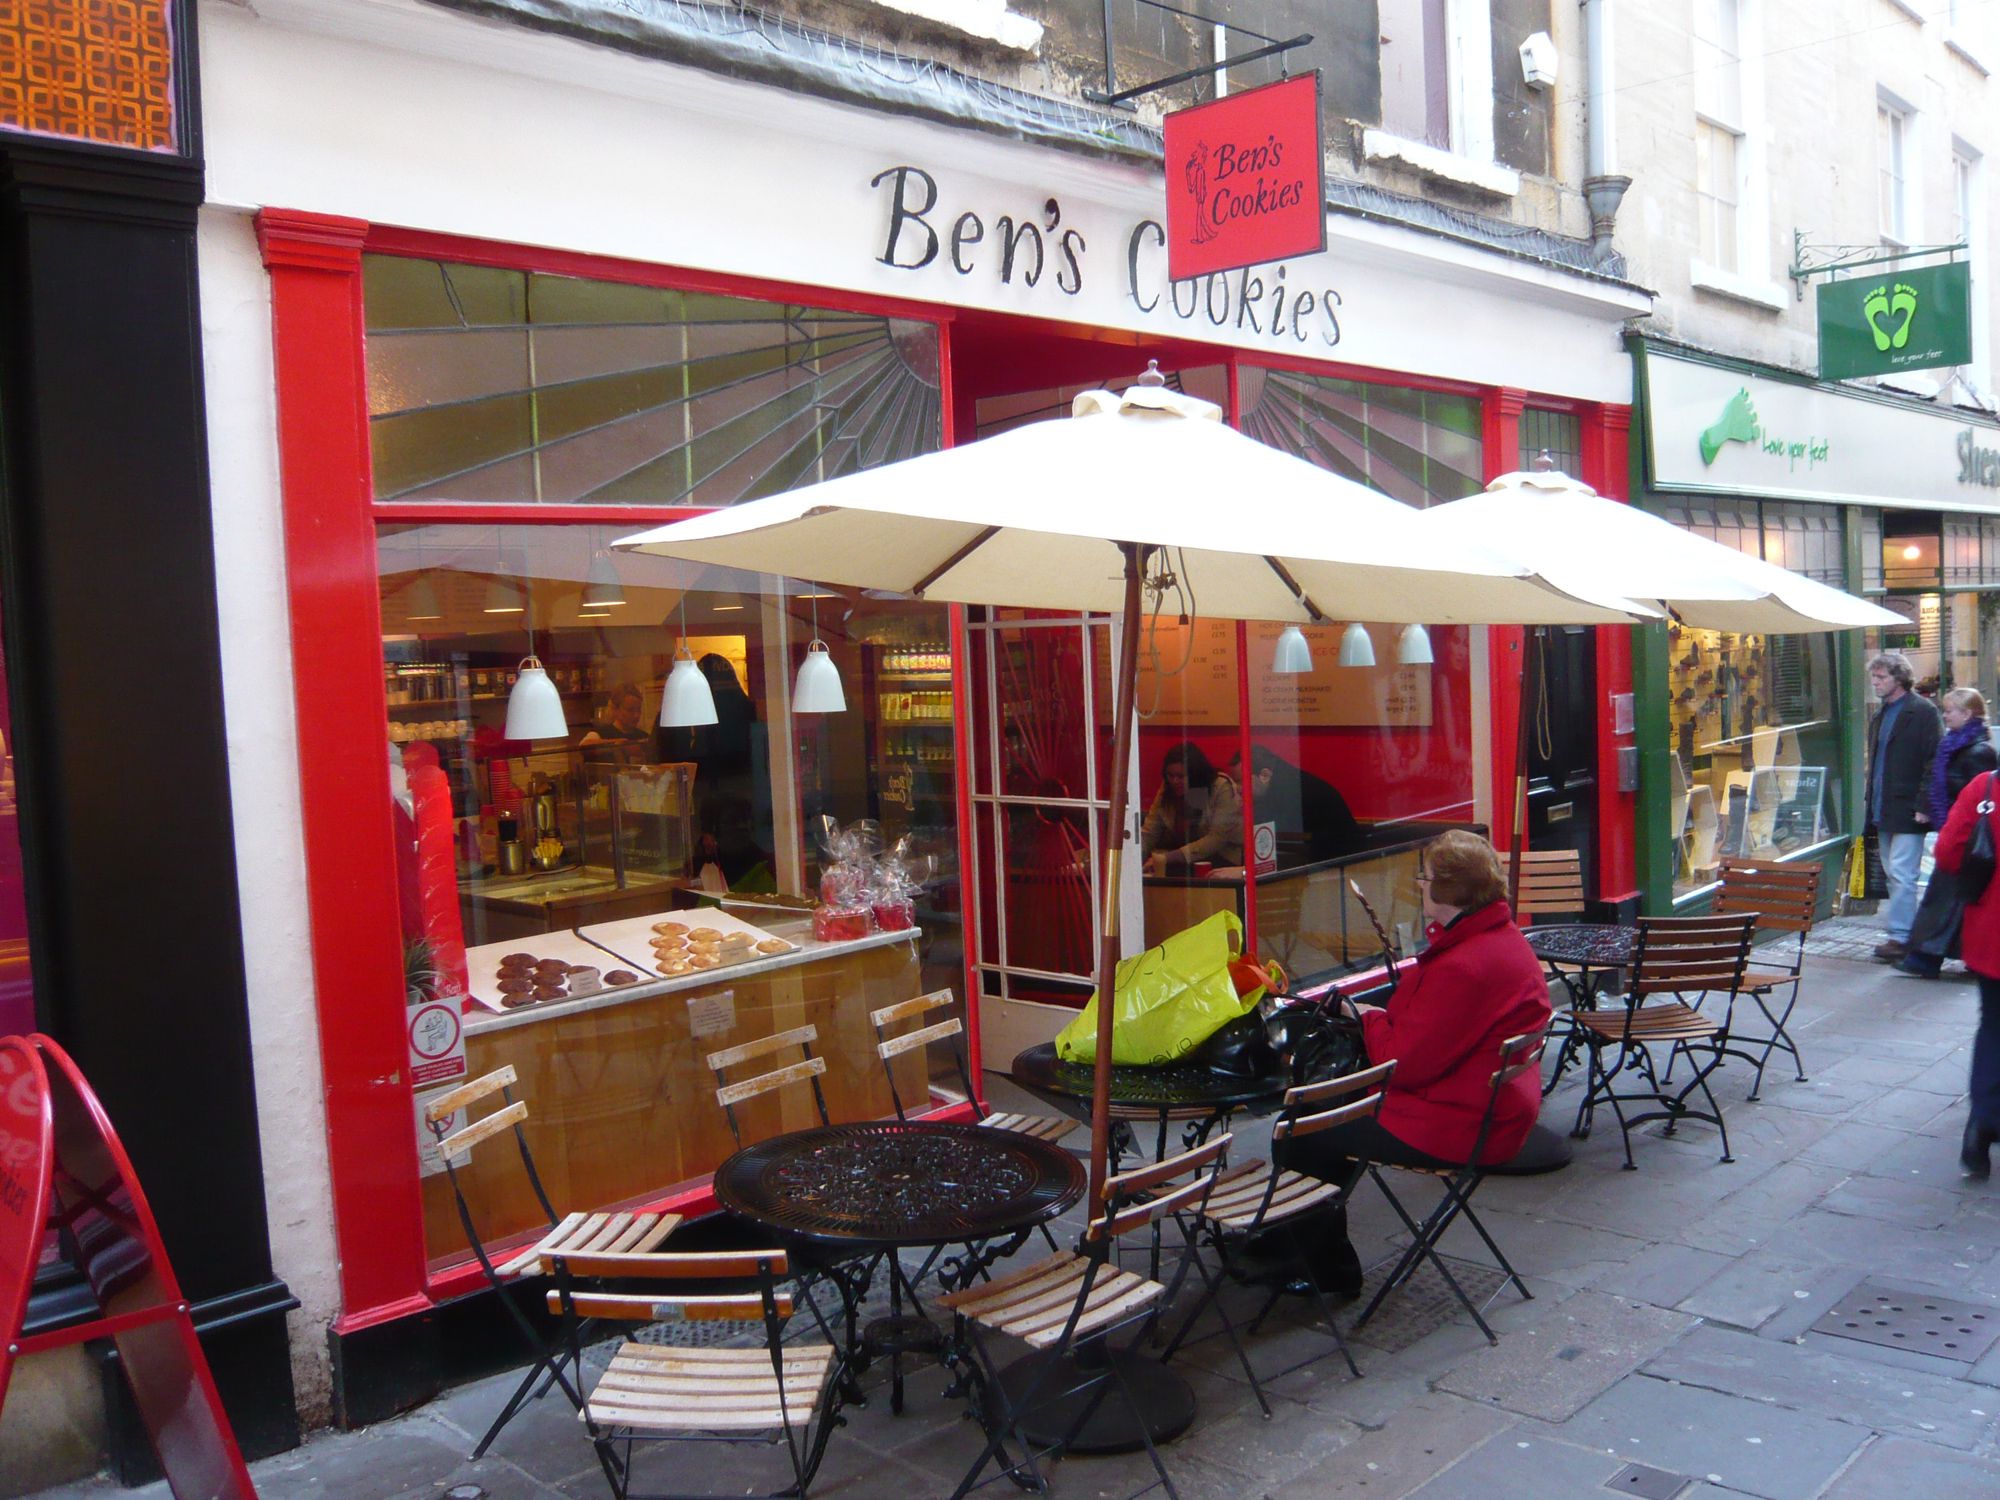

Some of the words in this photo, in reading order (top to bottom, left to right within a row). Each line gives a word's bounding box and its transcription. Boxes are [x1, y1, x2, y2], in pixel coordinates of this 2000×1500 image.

[1213, 134, 1283, 181] Ben's
[1212, 177, 1303, 226] Cookies
[871, 166, 1086, 295] Ben's
[1128, 219, 1342, 346] Cookies
[1762, 427, 1785, 457] Love
[1788, 441, 1807, 473] your
[1809, 435, 1829, 471] feet
